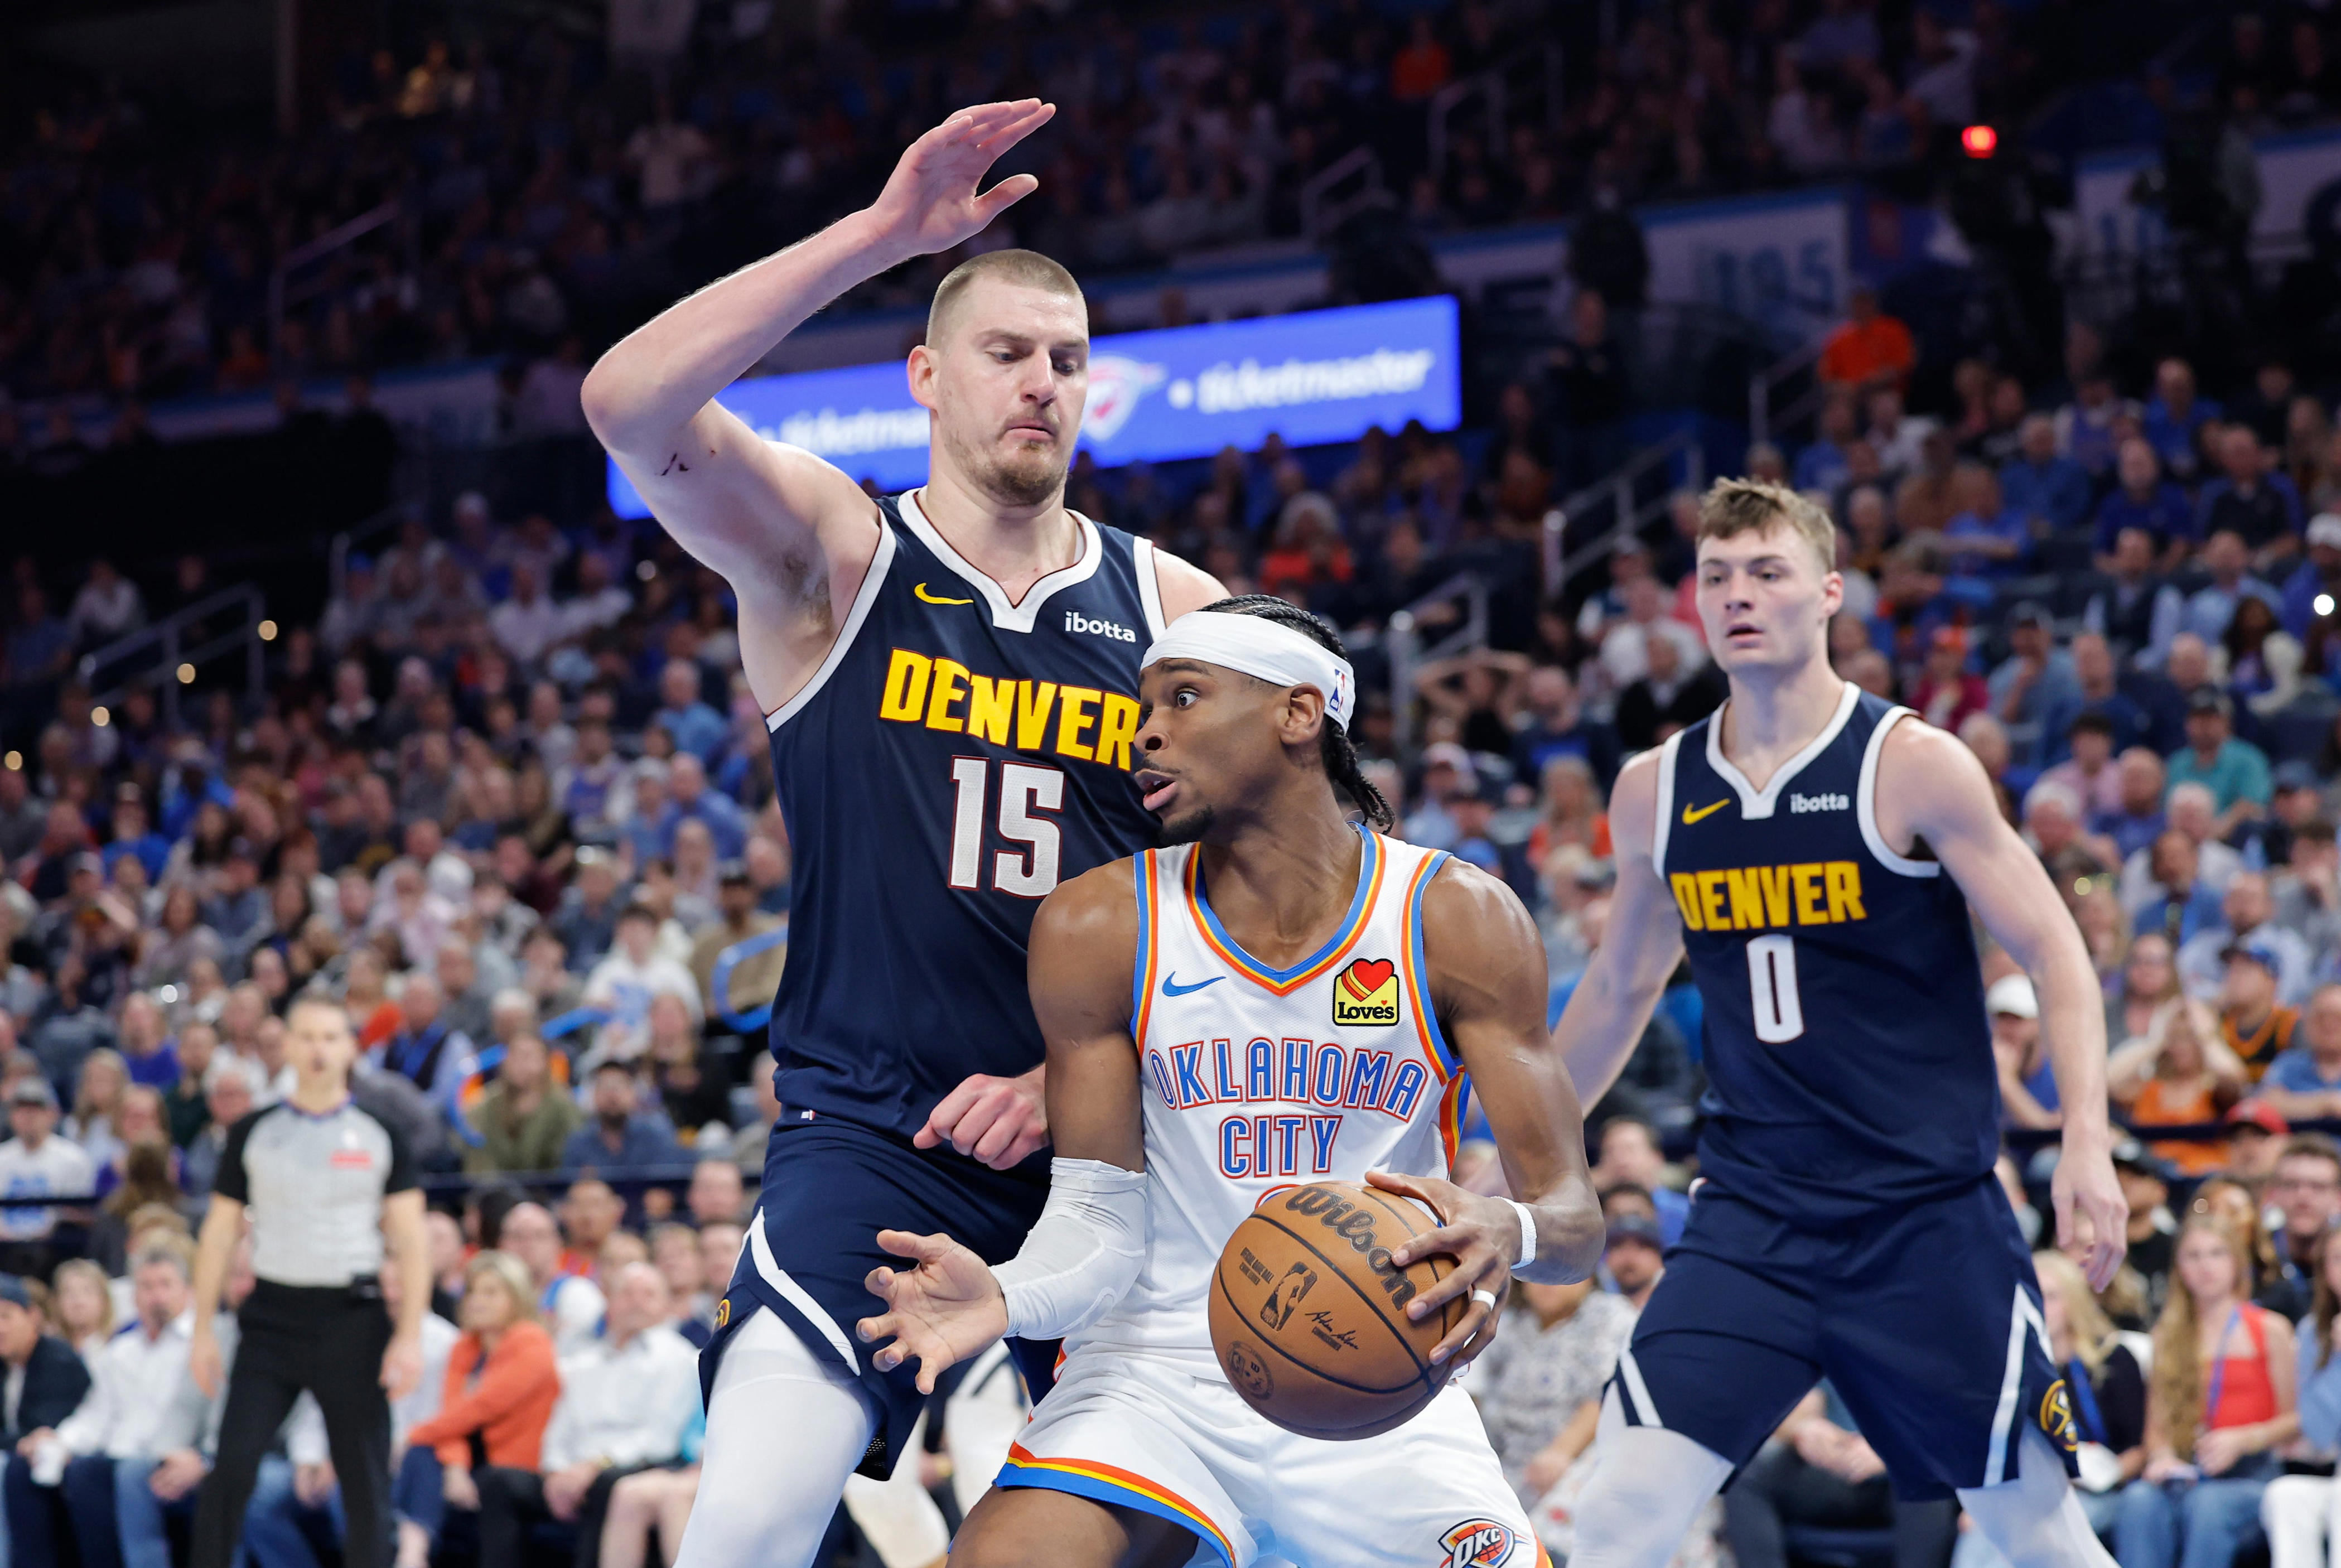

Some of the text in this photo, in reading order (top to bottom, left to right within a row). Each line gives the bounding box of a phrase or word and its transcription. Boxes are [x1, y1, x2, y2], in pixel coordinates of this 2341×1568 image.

[1065, 611, 1136, 643] ibotta
[879, 647, 1142, 771] DENVER
[948, 755, 1065, 899] 15
[1790, 793, 1850, 814] ibotta
[1669, 860, 1868, 932] DENVER
[1746, 933, 1805, 1044] 0
[1148, 1037, 1429, 1123] OKLAHOMA
[1219, 1115, 1343, 1179] CITY
[1286, 1186, 1416, 1311] Wilson
[1451, 1527, 1502, 1568] OKC
